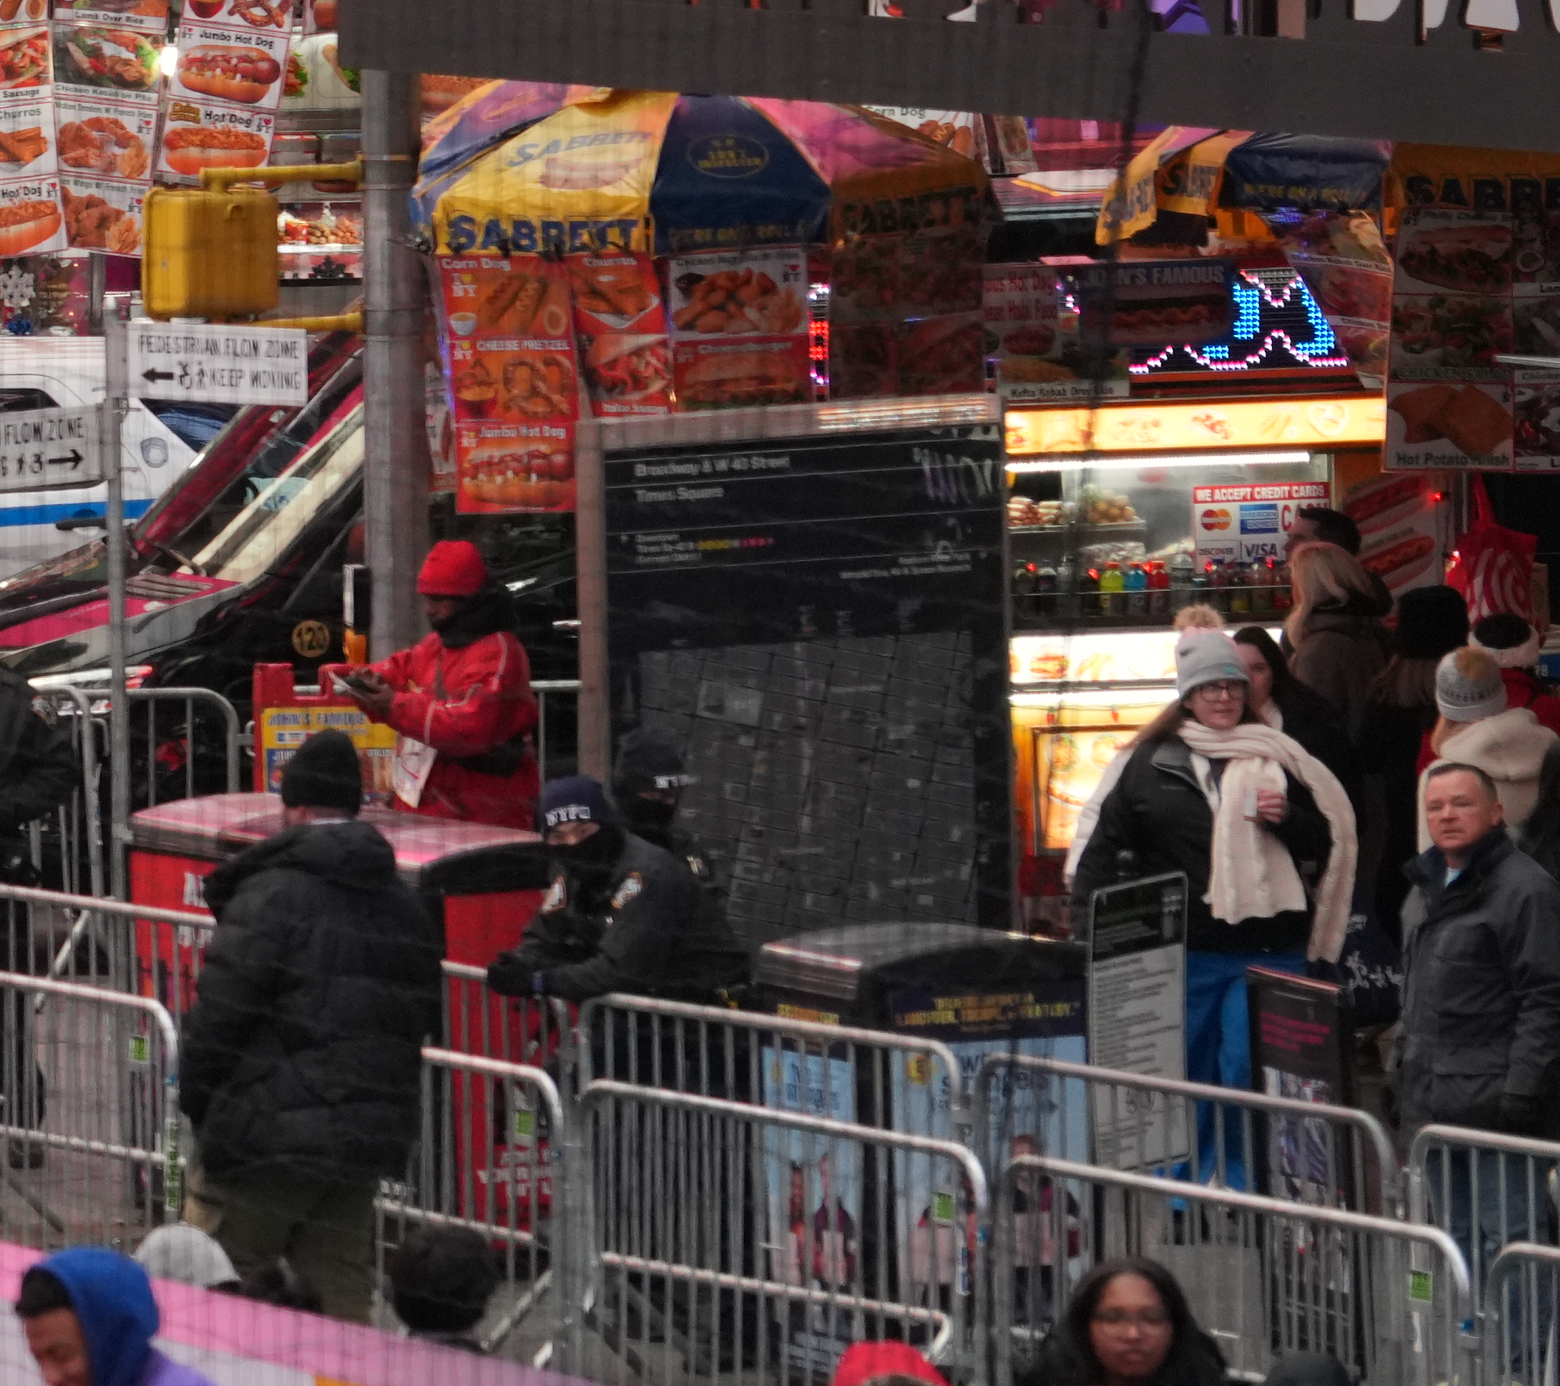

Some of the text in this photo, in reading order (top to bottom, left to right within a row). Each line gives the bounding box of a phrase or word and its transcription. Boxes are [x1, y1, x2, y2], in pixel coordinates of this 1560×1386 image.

[199, 28, 274, 50] Jumbo Hot Dog
[204, 110, 253, 128] Hot Dog
[899, 105, 926, 120] Dog
[506, 130, 653, 168] SABRETT
[1, 185, 43, 199] Hot Dog
[446, 213, 641, 255] SABRETT
[441, 256, 512, 271] Corn Dog
[138, 334, 300, 359] PEDESTRIAN FLOW ZONE
[209, 369, 302, 390] KEEP MOVING
[3, 420, 45, 445] FLOW
[47, 416, 85, 441] ZONE
[1395, 452, 1421, 468] Hot
[1195, 485, 1326, 502] WE ACCEPT CREDIT CARDS
[1244, 541, 1278, 558] VISA
